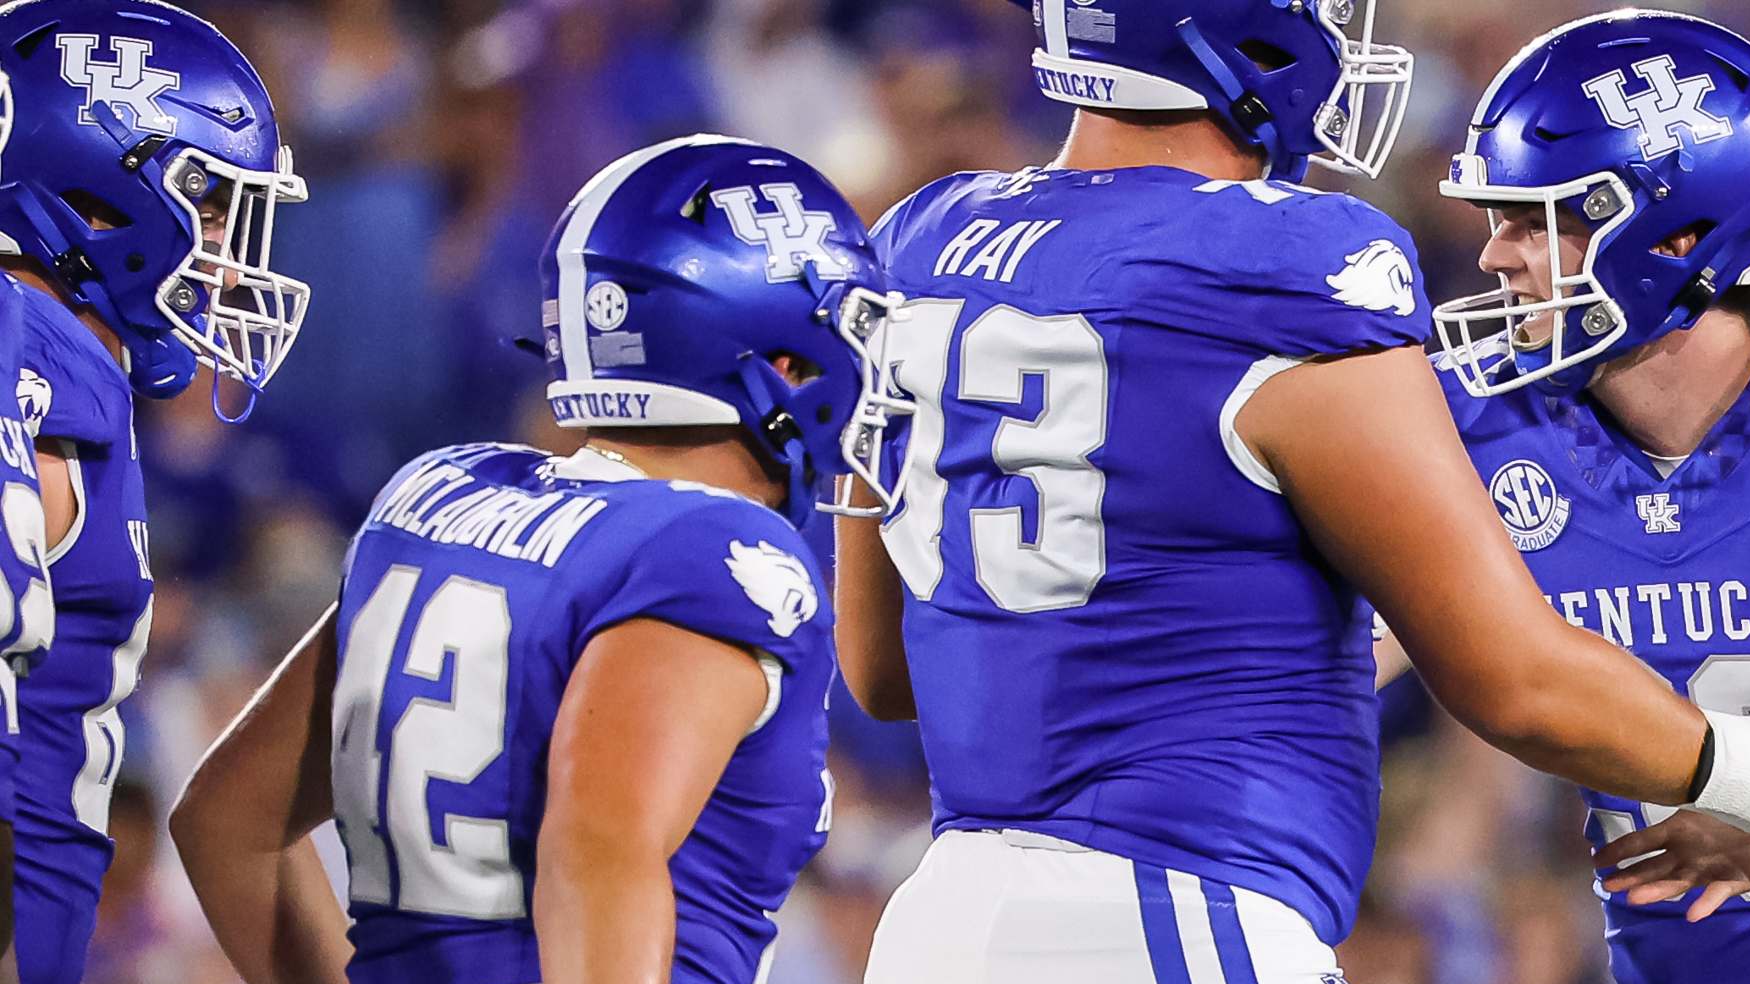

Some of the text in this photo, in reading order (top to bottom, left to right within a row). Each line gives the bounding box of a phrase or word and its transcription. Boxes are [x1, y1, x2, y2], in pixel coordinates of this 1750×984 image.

[55, 33, 180, 137] UK
[1581, 54, 1733, 162] UK
[710, 182, 852, 284] UK
[933, 218, 1063, 283] RAY
[866, 298, 1108, 613] 73
[1492, 463, 1554, 531] SEC
[1512, 514, 1565, 551] RADUATE
[1635, 493, 1681, 534] UK
[331, 563, 527, 919] 42
